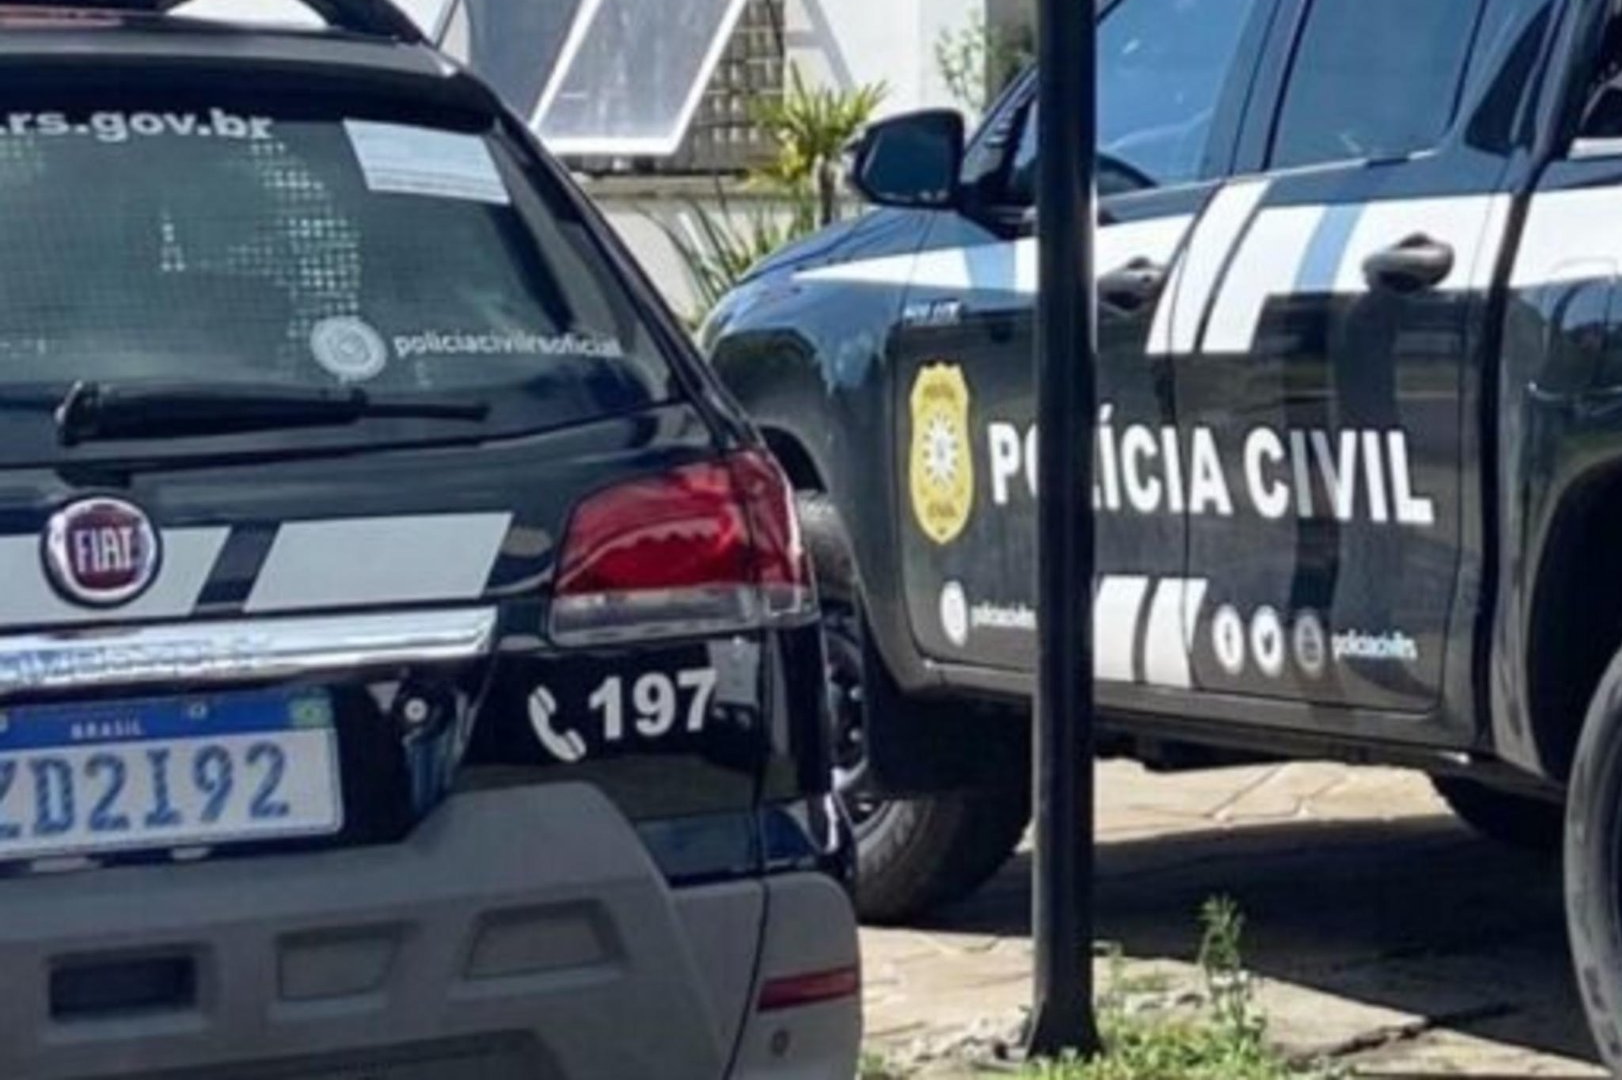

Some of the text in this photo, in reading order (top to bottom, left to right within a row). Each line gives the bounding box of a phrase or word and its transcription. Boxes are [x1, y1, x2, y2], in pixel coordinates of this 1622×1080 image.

[988, 403, 1435, 523] PÍCIA CIVIL
[73, 525, 134, 574] FIAT
[70, 717, 143, 740] BRASIL
[586, 668, 719, 740] 197
